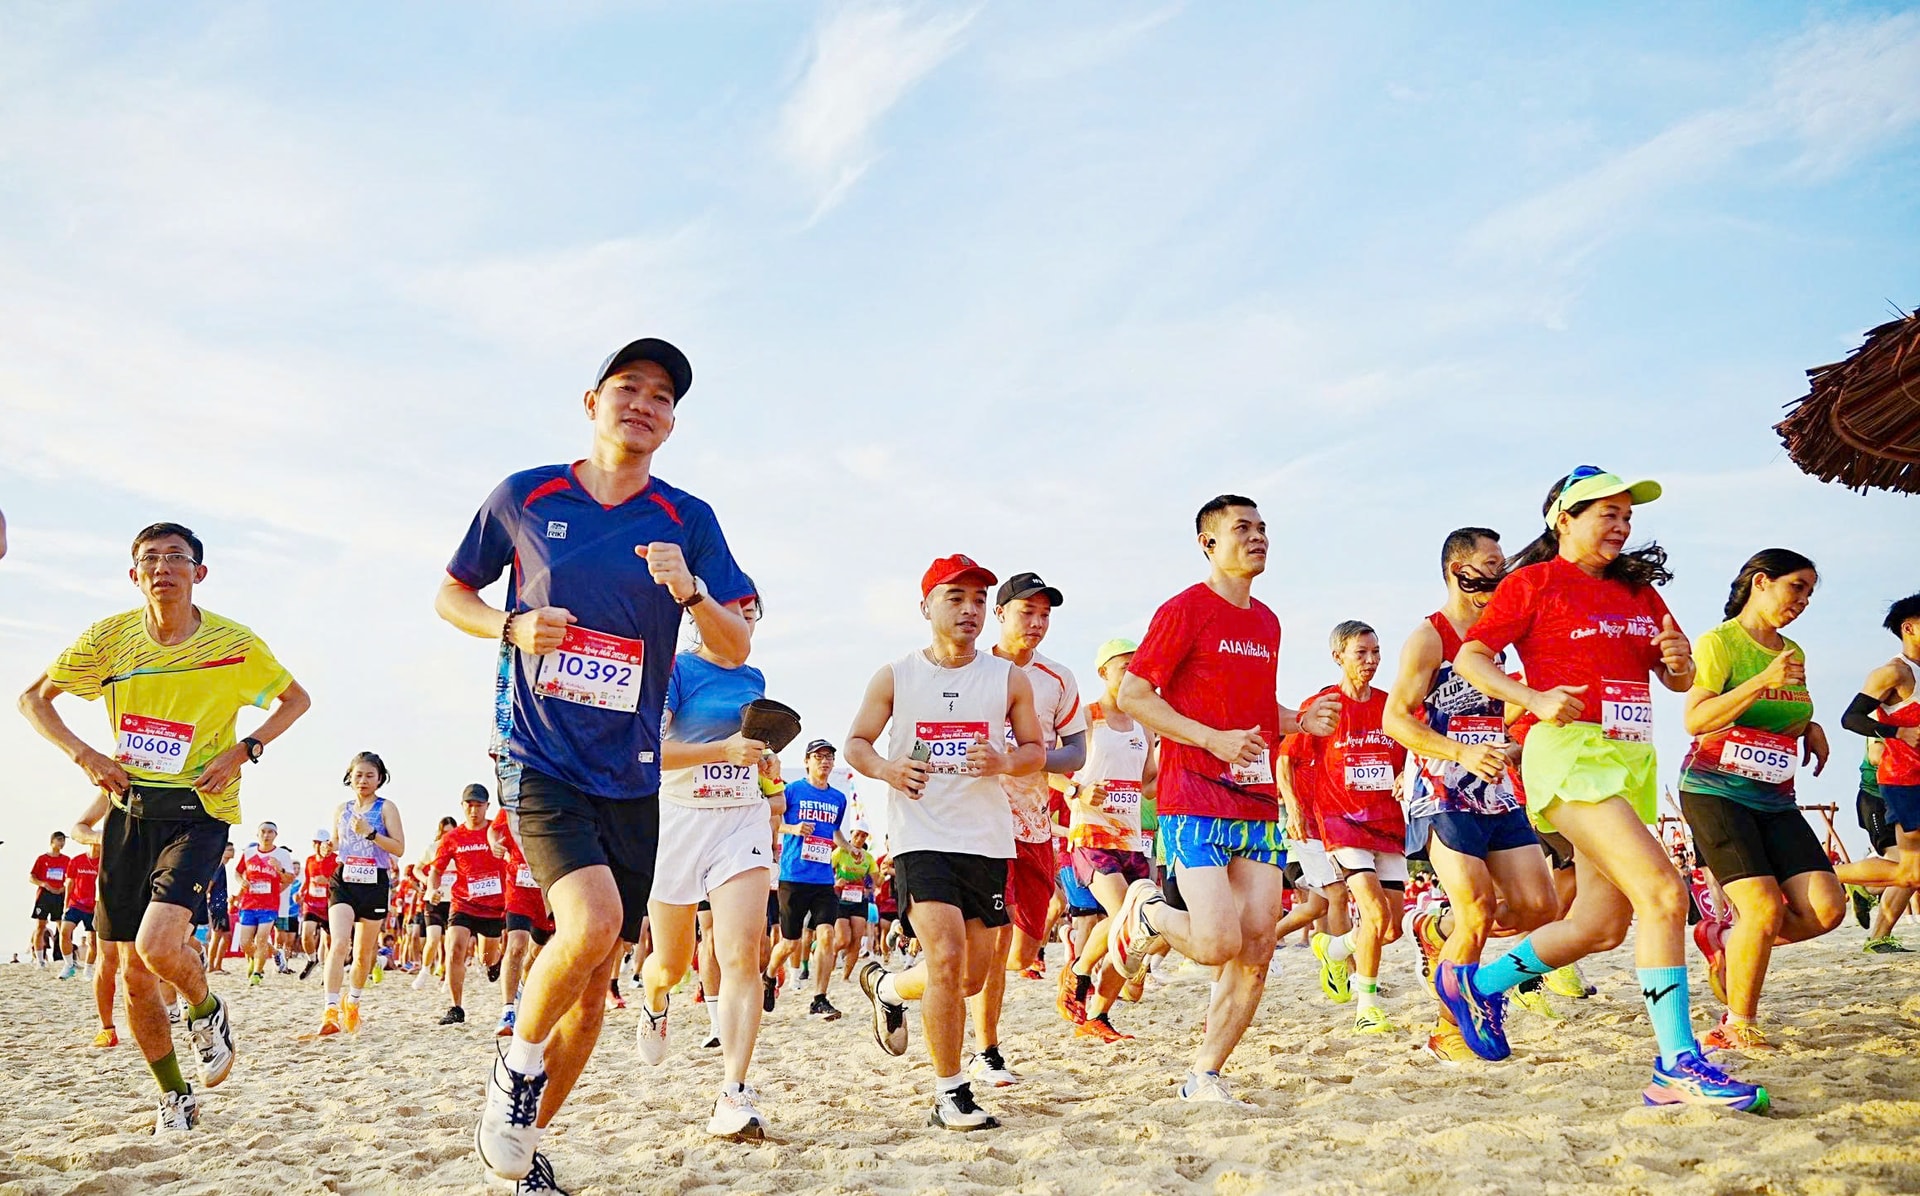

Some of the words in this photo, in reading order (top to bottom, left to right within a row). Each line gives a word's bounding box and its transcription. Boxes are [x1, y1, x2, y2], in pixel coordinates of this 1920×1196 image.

[558, 652, 632, 687] 10392
[126, 733, 181, 757] 10608
[1734, 744, 1789, 769] 10055
[702, 764, 751, 780] 10372
[1352, 766, 1386, 779] 10197
[1109, 792, 1138, 804] 10530
[807, 844, 829, 855] 10537
[348, 866, 375, 875] 10466
[472, 880, 497, 891] 10245
